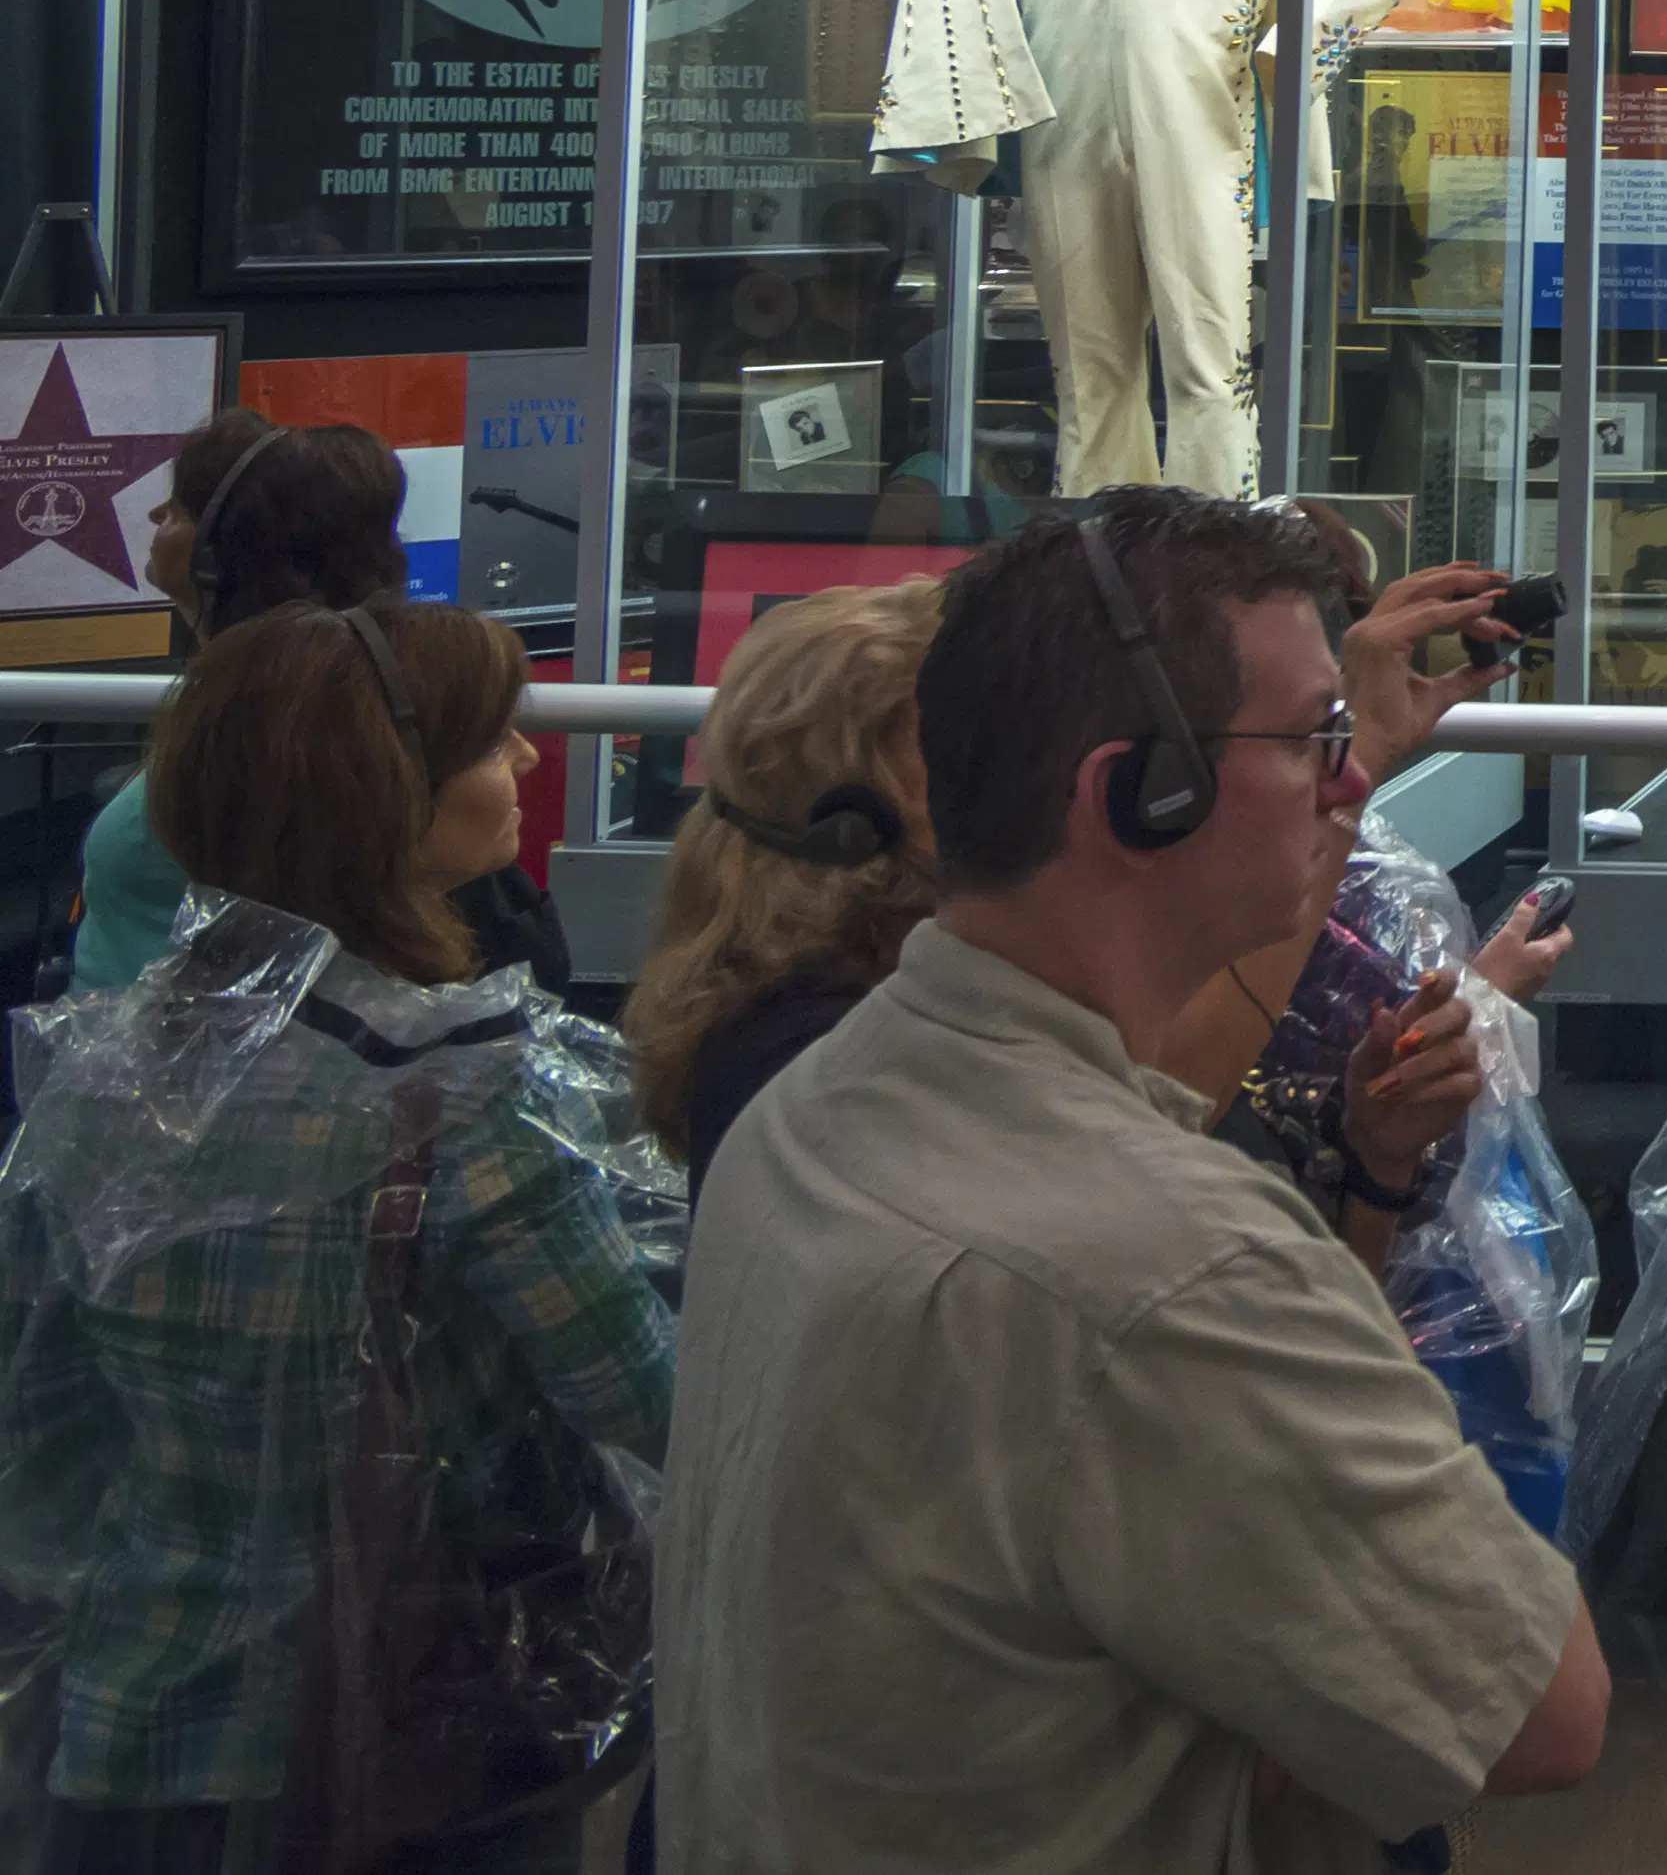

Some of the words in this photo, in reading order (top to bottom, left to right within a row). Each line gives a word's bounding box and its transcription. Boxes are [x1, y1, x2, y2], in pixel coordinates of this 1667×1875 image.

[391, 61, 421, 88] TO
[432, 61, 475, 88] THE
[485, 62, 563, 88] ESTATE
[573, 62, 600, 89] OF
[679, 65, 769, 89] PRESLEY
[344, 97, 554, 123] COMMEMORATING
[741, 98, 810, 125] SALES
[1621, 103, 1640, 111] Film
[1621, 114, 1640, 122] Love
[1613, 124, 1648, 135] Country
[1543, 134, 1559, 143] The
[359, 132, 388, 159] OF
[399, 132, 466, 159] MORE
[479, 132, 540, 159] THAN
[706, 131, 791, 157] ALBUMS
[1623, 169, 1664, 178] Collection
[320, 167, 389, 194] FROM
[399, 167, 454, 194] BMG
[658, 165, 818, 190] INTERNATIONAL
[1610, 180, 1625, 188] The
[1627, 180, 1652, 188] Dutch
[1604, 191, 1625, 199] Elvis
[1626, 191, 1641, 200] For
[1623, 201, 1641, 210] Blue
[484, 201, 572, 227] AUGUST
[1625, 224, 1653, 234] Moody
[508, 398, 577, 413] ALWAYS
[0, 455, 40, 469] ELVIS
[45, 453, 111, 467] PRESLEY
